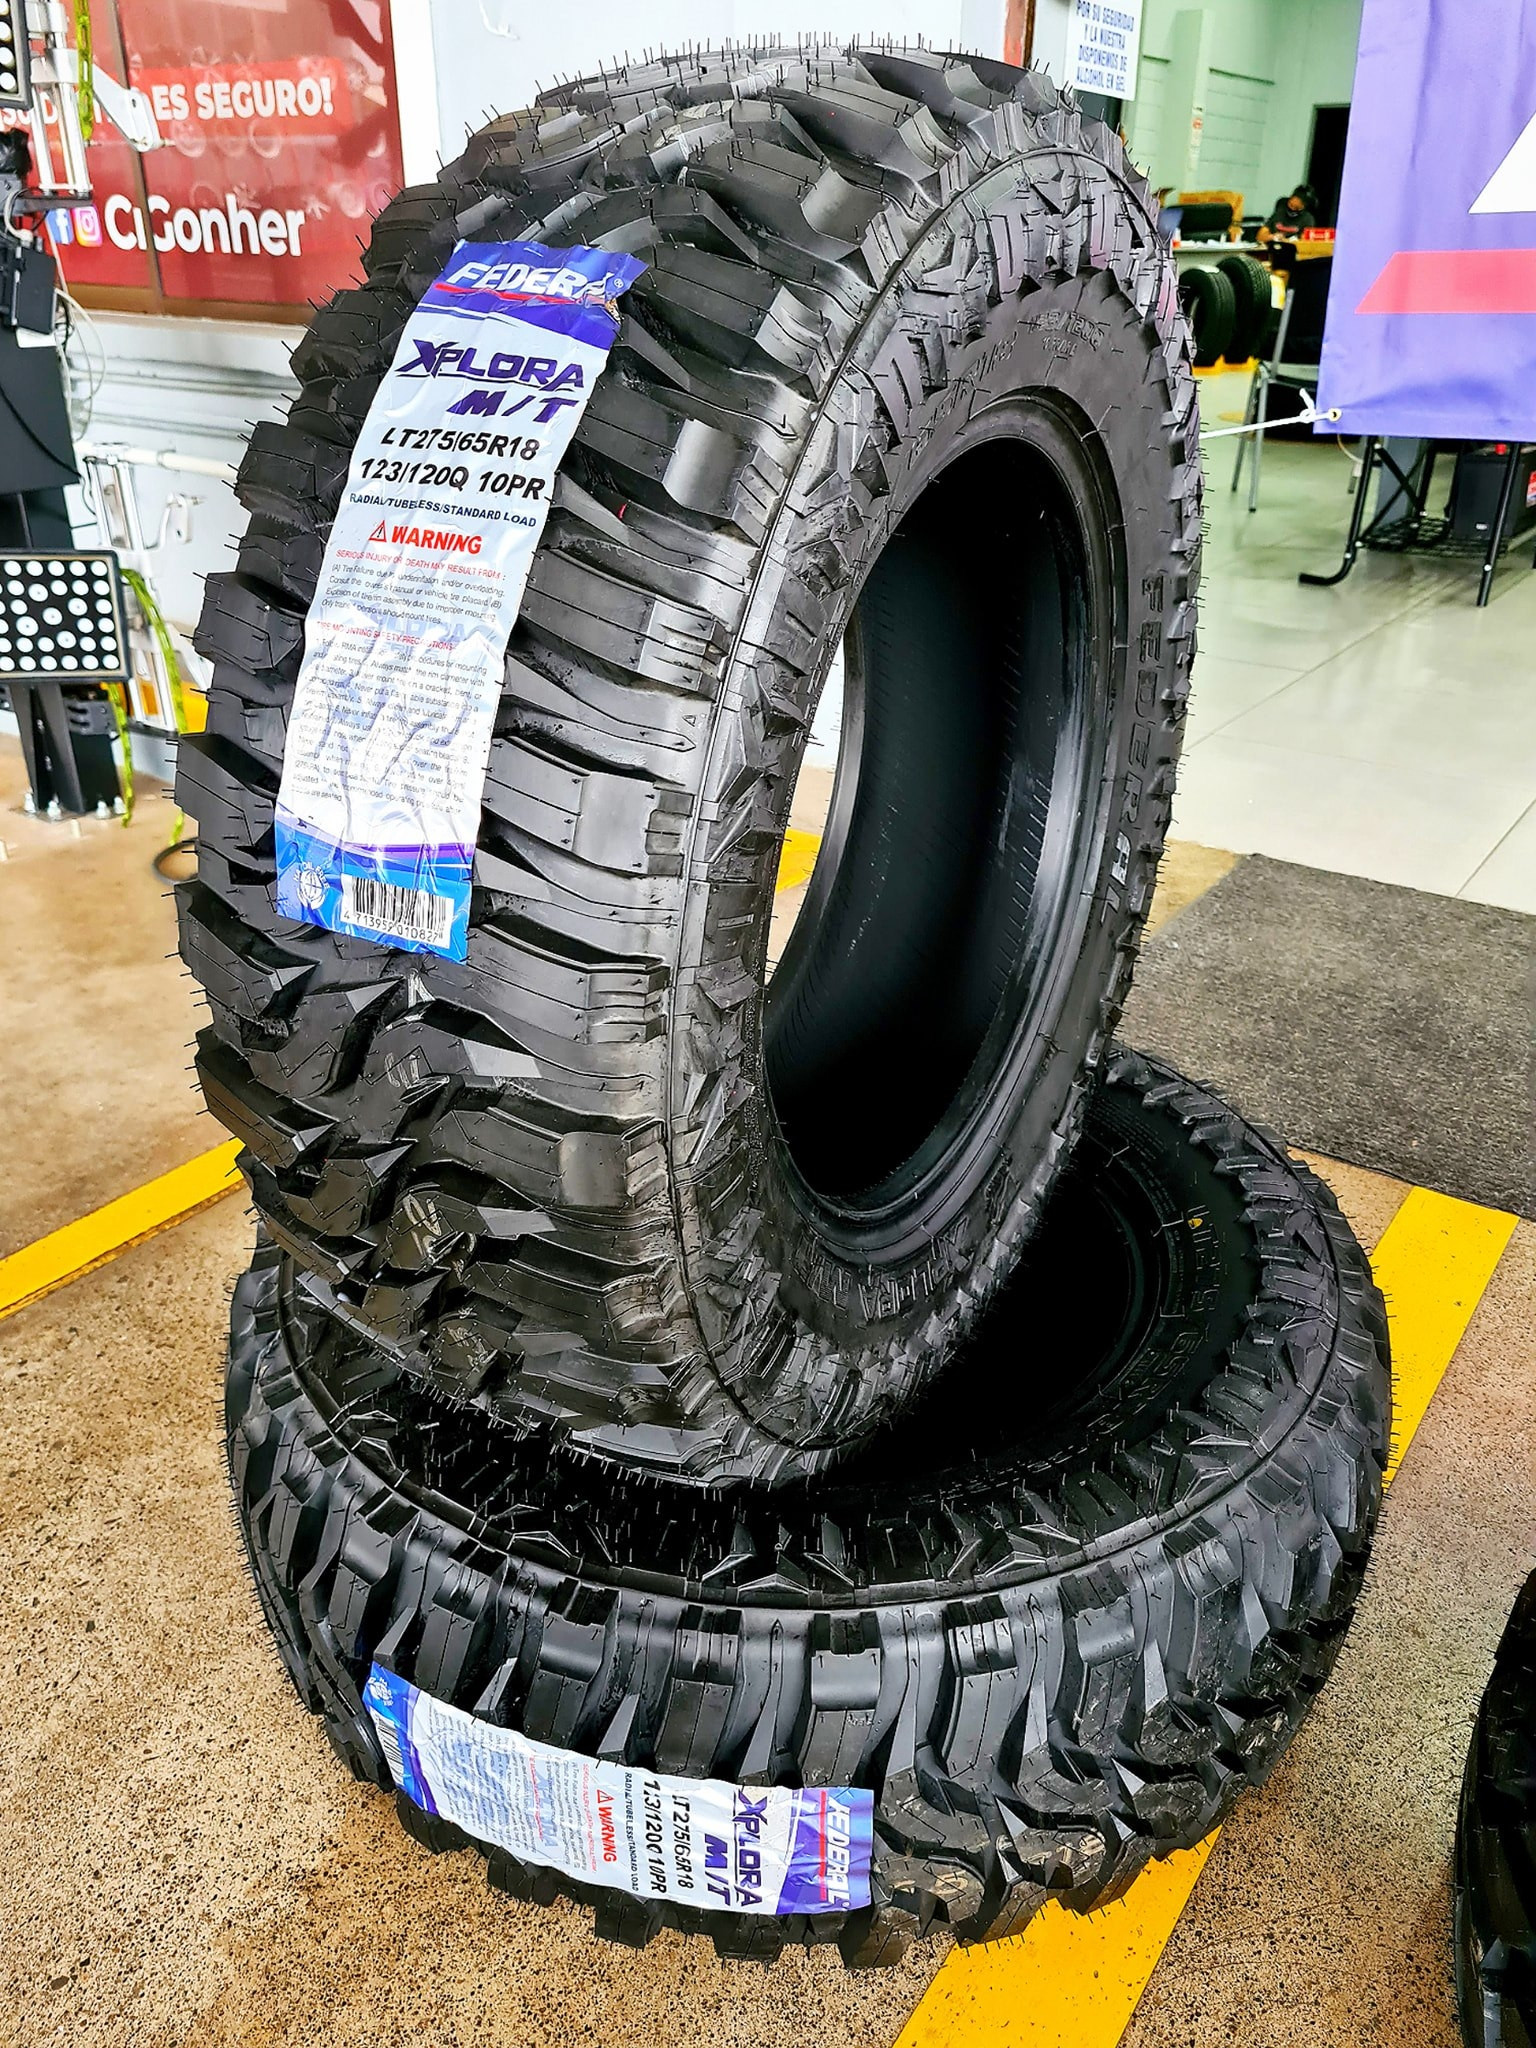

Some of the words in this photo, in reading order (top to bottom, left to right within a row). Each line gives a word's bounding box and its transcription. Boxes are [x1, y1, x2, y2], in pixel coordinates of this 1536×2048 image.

[1099, 28, 1126, 50] NUESTRA
[152, 84, 189, 121] ES
[195, 78, 334, 119] SEGURO!
[394, 338, 585, 392] XPLORA
[446, 389, 580, 423] M/T
[381, 427, 542, 461] LT275/65R18
[360, 457, 470, 493] 123/120Q
[478, 470, 547, 501] 10PR
[502, 511, 538, 528] LOAD
[391, 526, 482, 555] WARNING
[732, 1788, 768, 1907] XPLORA
[704, 1833, 731, 1907] M/T
